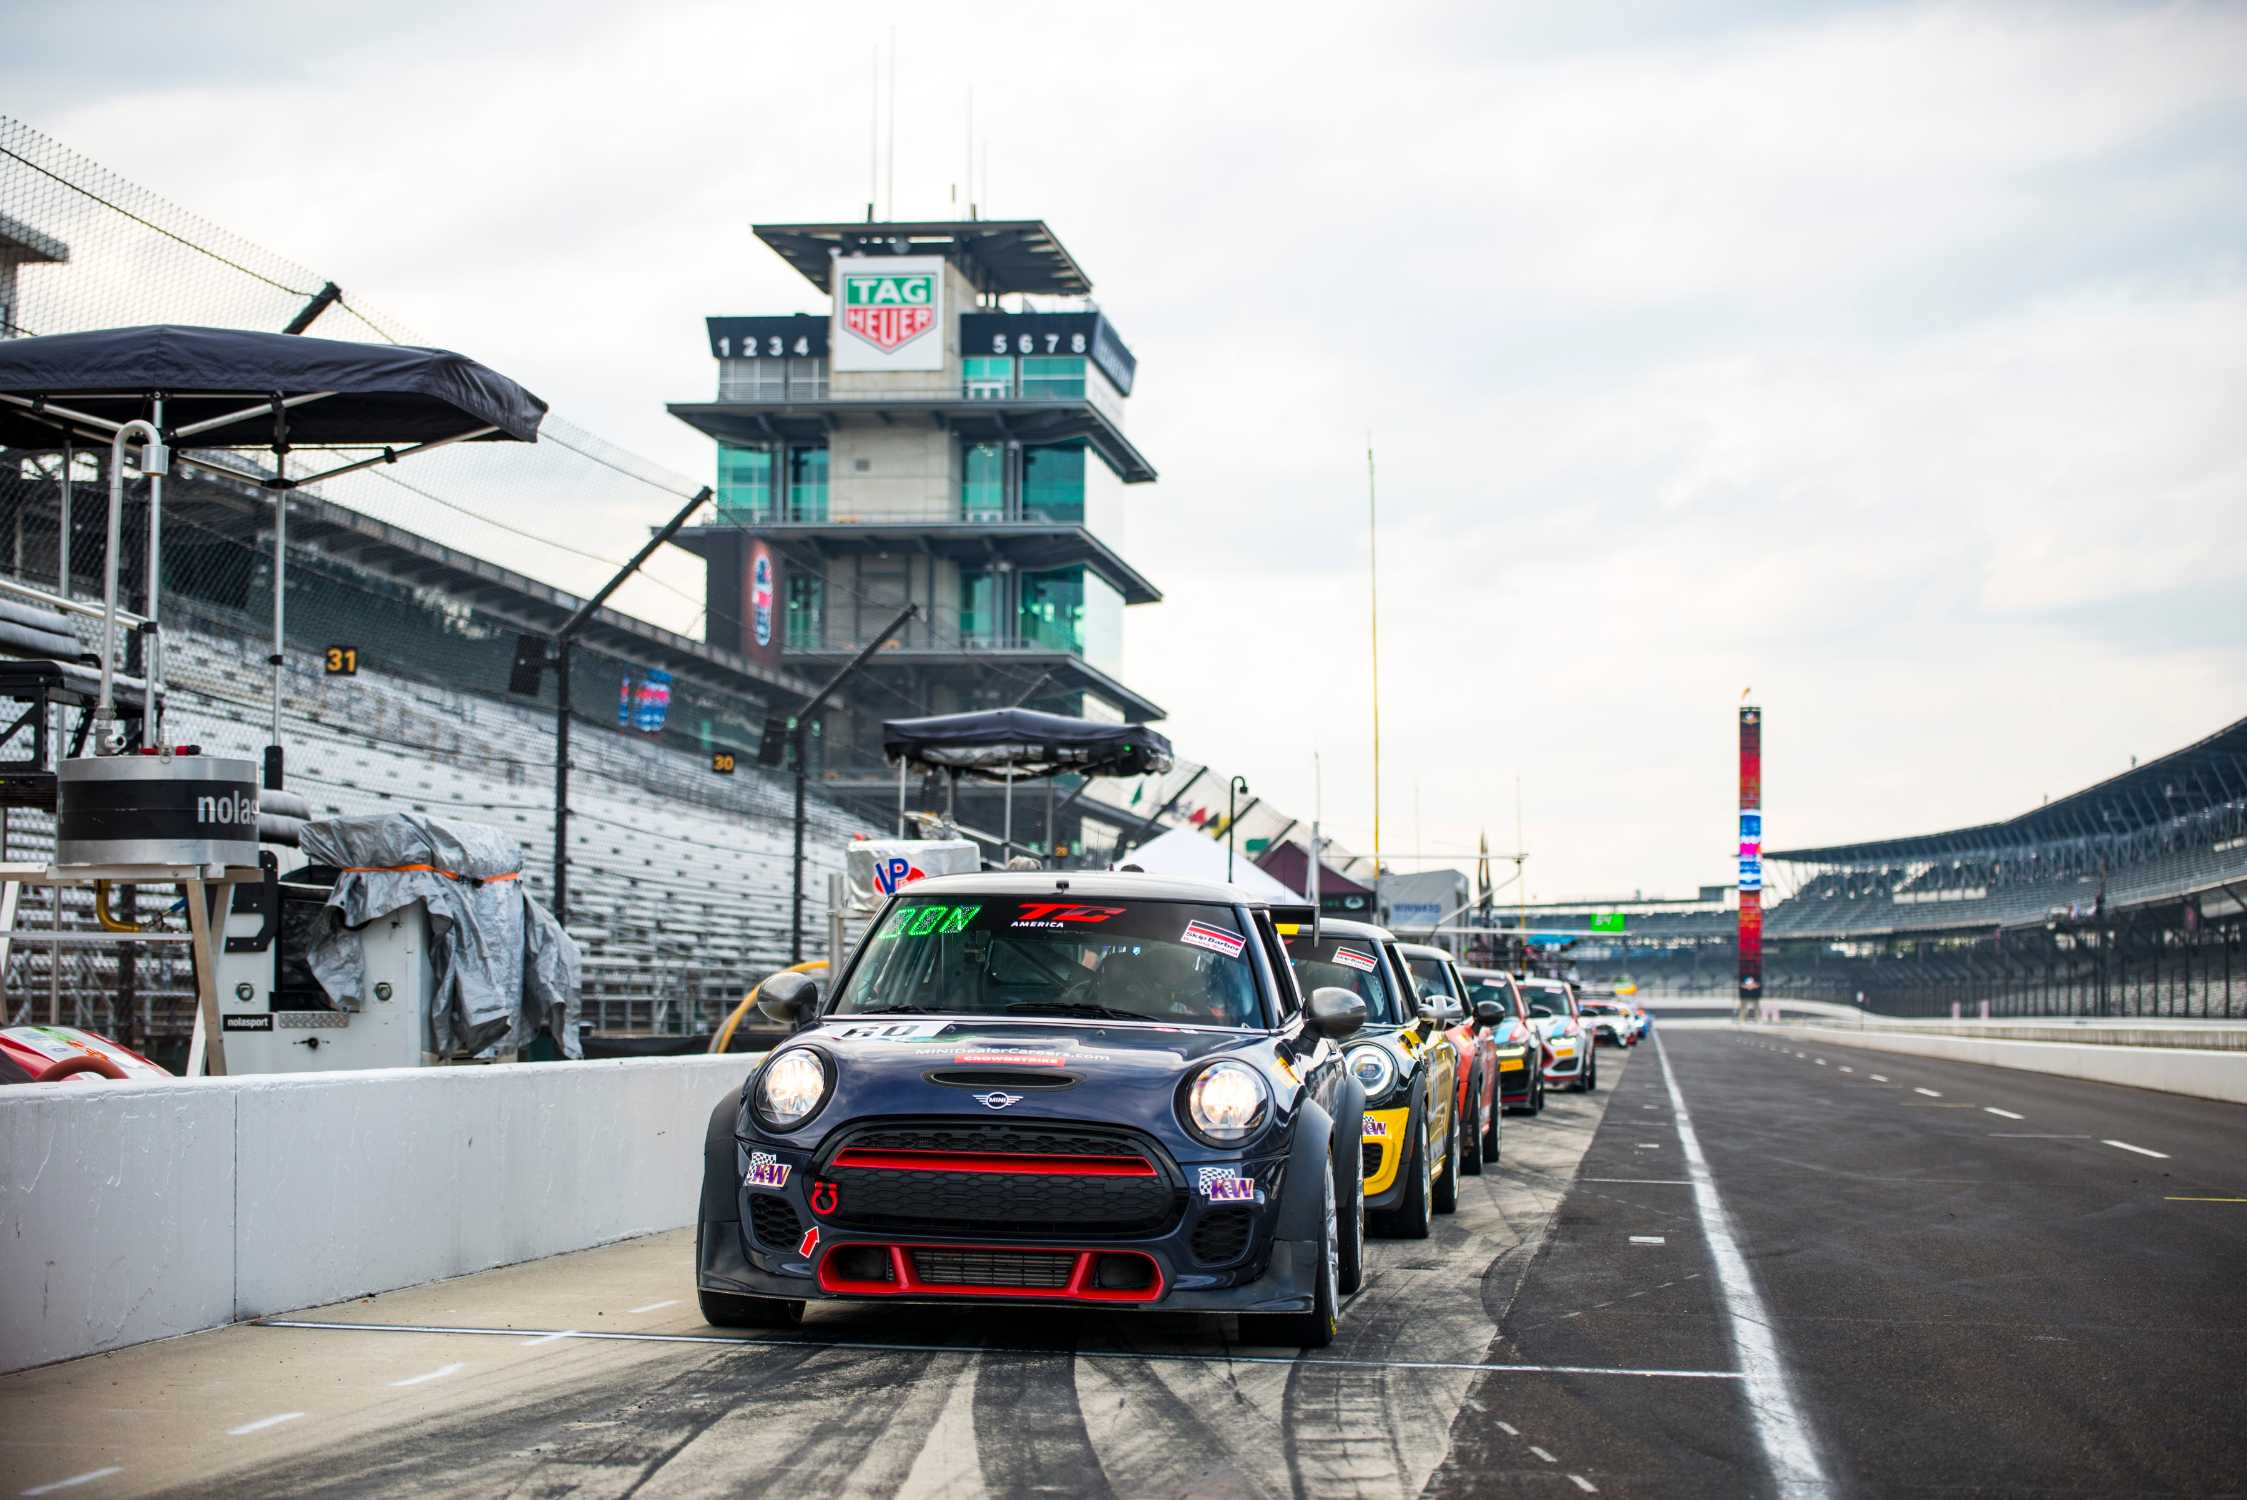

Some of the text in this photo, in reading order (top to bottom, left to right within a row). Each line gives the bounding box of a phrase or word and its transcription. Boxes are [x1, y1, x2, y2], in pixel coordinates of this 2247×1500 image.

[851, 279, 927, 304] TAG
[847, 309, 931, 346] HEUER
[717, 335, 810, 357] 1 2 3 4
[992, 333, 1086, 354] 5 6 7 8
[327, 648, 356, 672] 31
[875, 858, 910, 896] VP
[1010, 920, 1064, 929] AMERICA
[1207, 937, 1239, 951] Barber
[227, 1016, 268, 1029] nolasport
[841, 1025, 919, 1037] 60
[988, 1096, 1006, 1104] MINI
[754, 1164, 790, 1185] KW
[1211, 1179, 1254, 1199] KW
